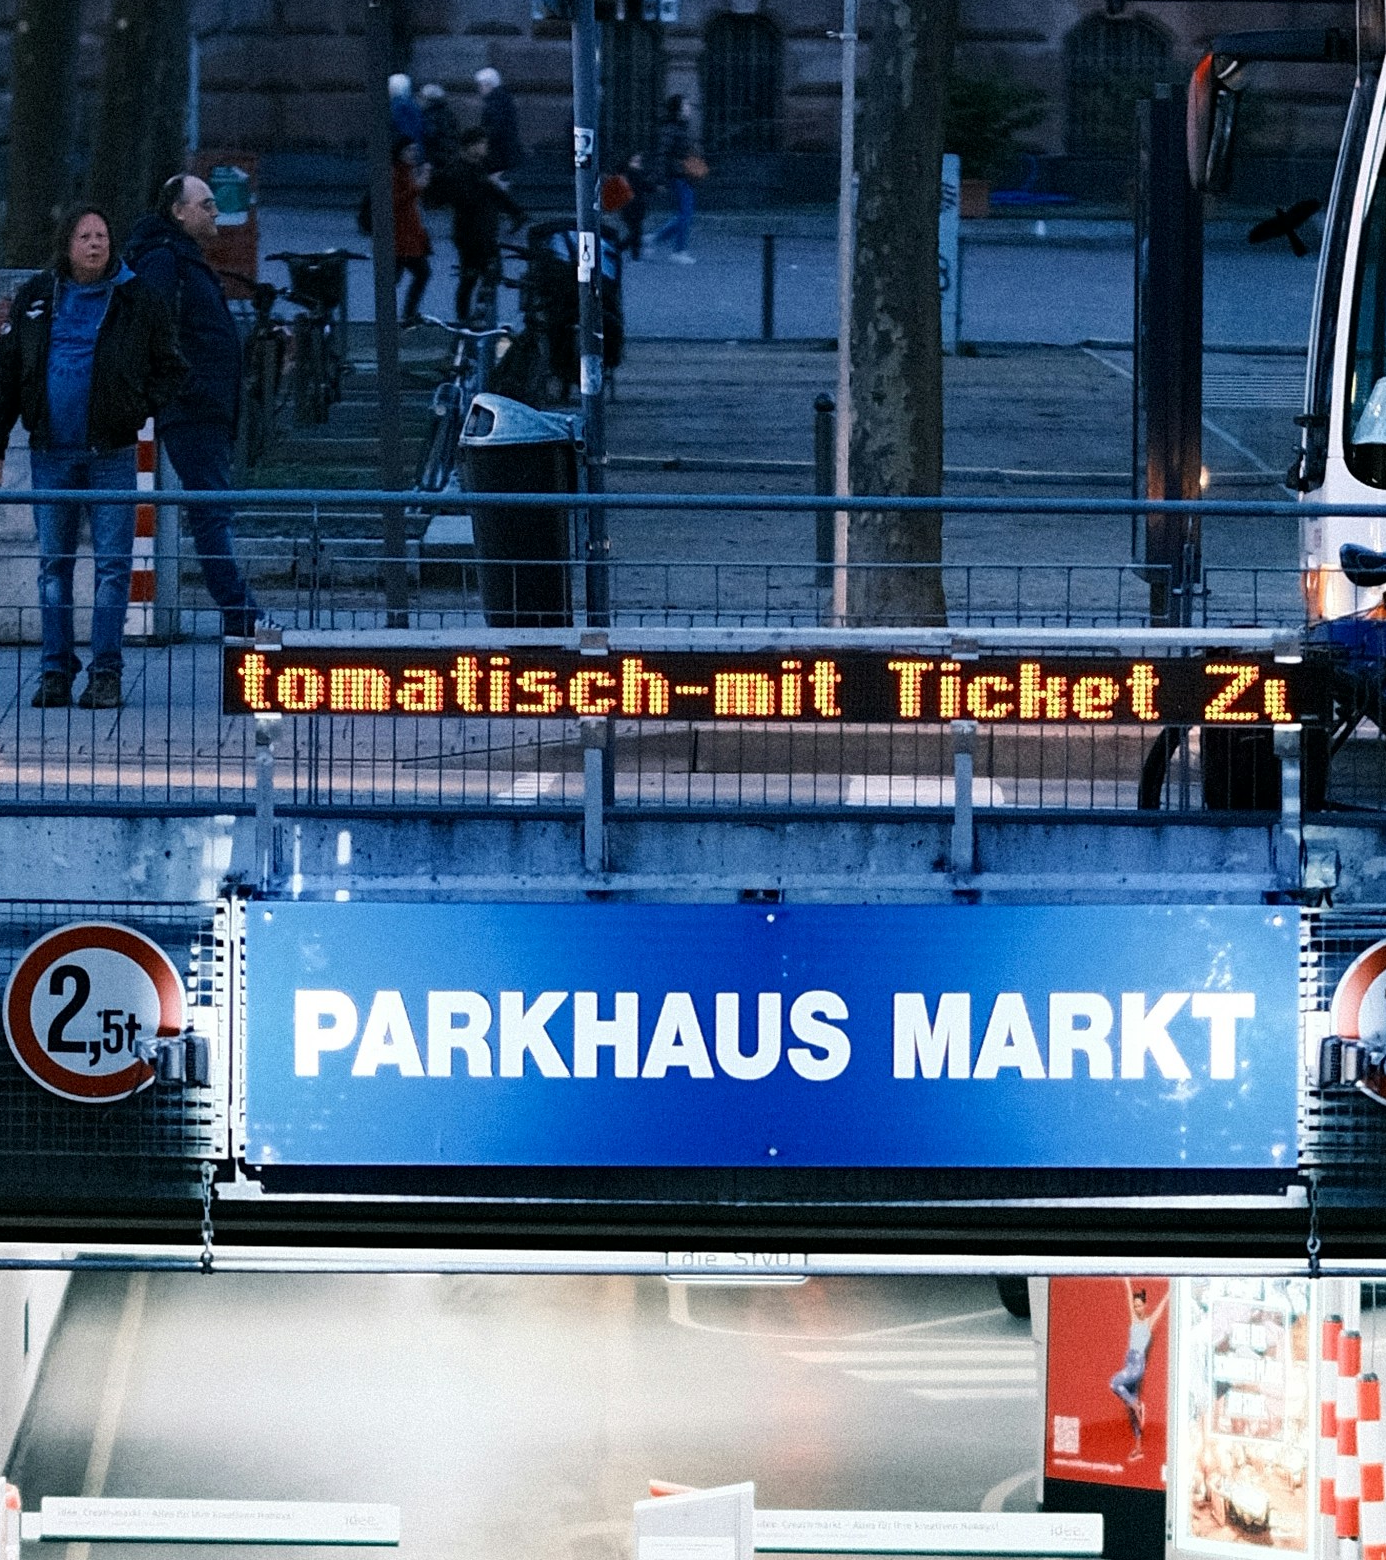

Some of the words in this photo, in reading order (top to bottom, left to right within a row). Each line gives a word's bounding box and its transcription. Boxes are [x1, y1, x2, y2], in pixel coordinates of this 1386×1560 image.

[237, 652, 842, 718] tomatisch-mit
[888, 660, 1160, 722] Ticket
[293, 987, 851, 1083] PARKHAUS
[892, 989, 1256, 1083] MARKT
